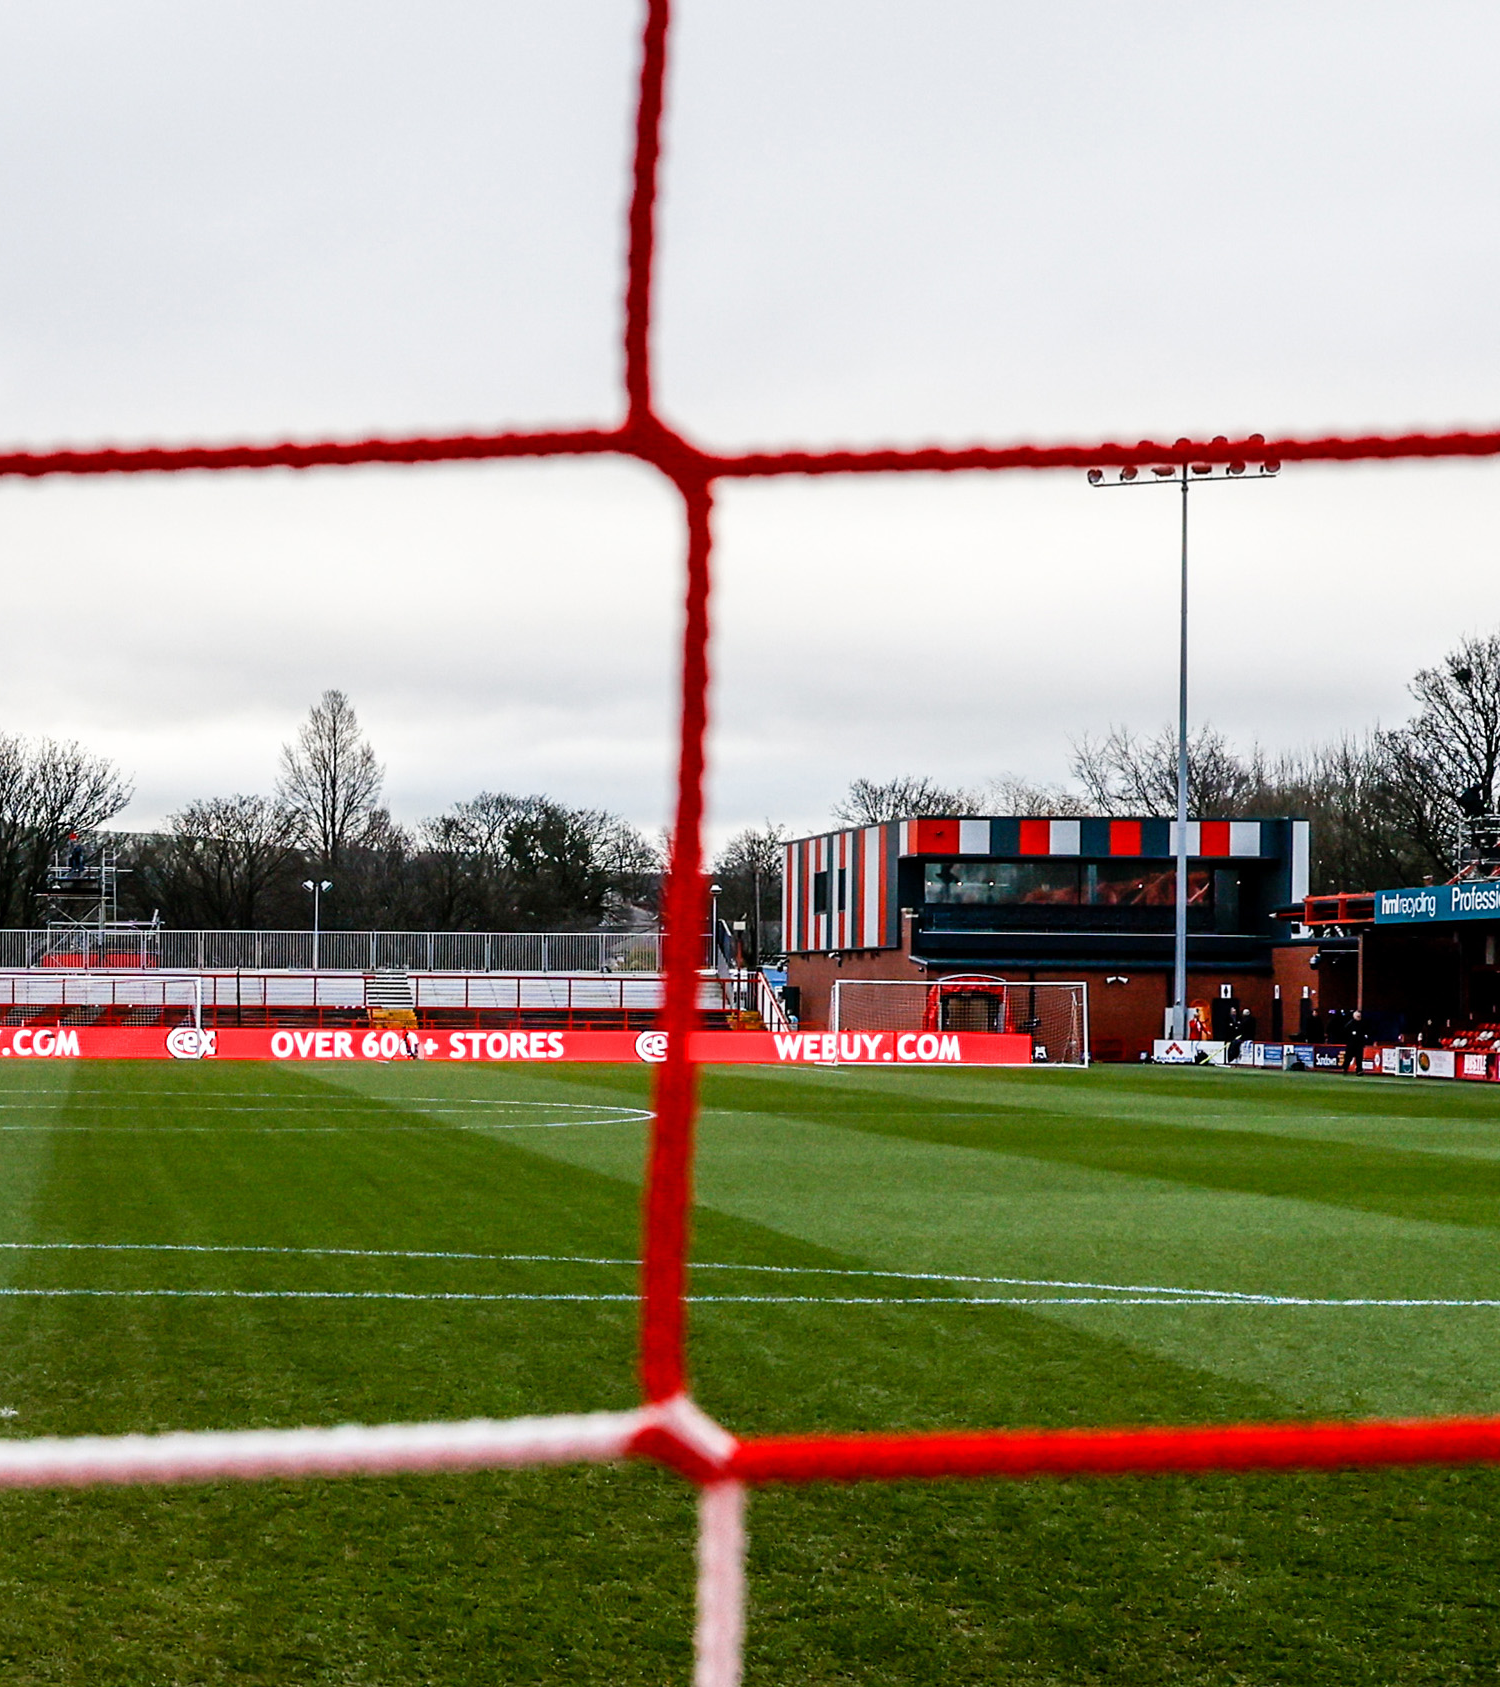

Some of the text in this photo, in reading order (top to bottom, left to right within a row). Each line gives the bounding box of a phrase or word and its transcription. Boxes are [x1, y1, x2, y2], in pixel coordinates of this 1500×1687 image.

[271, 1031, 354, 1058] OVER
[450, 1032, 564, 1058] STORES
[774, 1034, 960, 1060] WEBUY.COM
